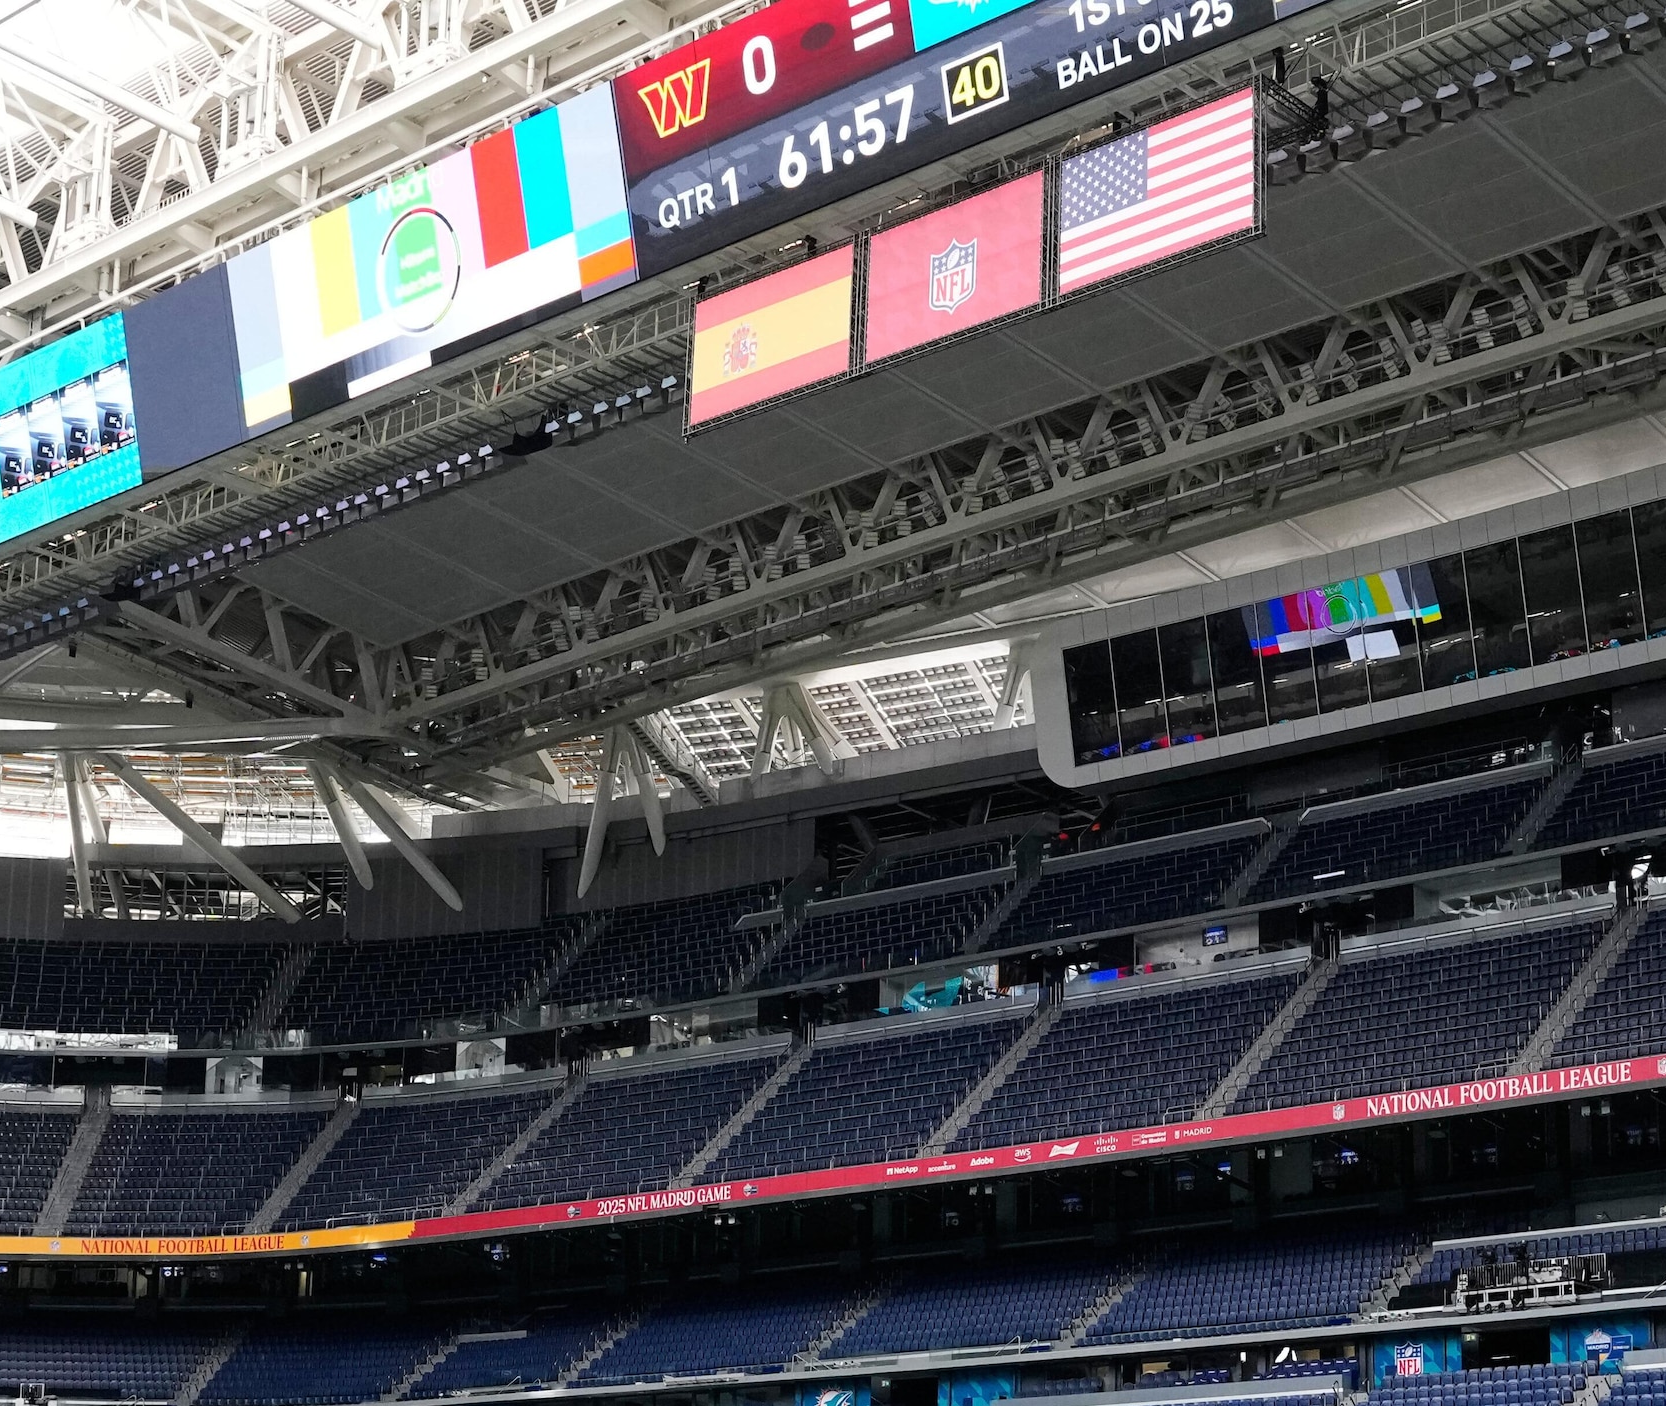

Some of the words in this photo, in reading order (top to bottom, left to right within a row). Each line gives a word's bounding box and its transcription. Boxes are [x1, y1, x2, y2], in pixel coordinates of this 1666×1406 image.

[1056, 37, 1132, 90] BALL
[1137, 13, 1185, 55] ON
[1189, 0, 1234, 38] 25
[741, 34, 777, 96] 0
[950, 56, 1001, 108] 40
[657, 178, 716, 230] QTR
[720, 165, 739, 207] 1
[777, 84, 916, 190] 61:57
[932, 265, 972, 306] NFL
[1366, 1084, 1454, 1118] NATIONAL
[1459, 1071, 1553, 1105] FOOTBALL
[1558, 1061, 1632, 1093] LEAGUE
[1183, 1127, 1212, 1138] MADRID
[1015, 1148, 1031, 1157] aws
[1096, 1144, 1116, 1153] CISCO
[894, 1166, 918, 1175] NetApp
[928, 1163, 956, 1173] accenture
[970, 1156, 994, 1167] Adobe
[597, 1198, 625, 1216] 2025
[627, 1195, 648, 1212] NFL
[650, 1189, 696, 1209] MADRID
[697, 1185, 731, 1203] GAME
[80, 1239, 152, 1254] NATIONAL
[157, 1237, 228, 1253] FOOTBALL
[233, 1235, 285, 1251] LEAGUE
[1397, 1357, 1421, 1376] NFL
